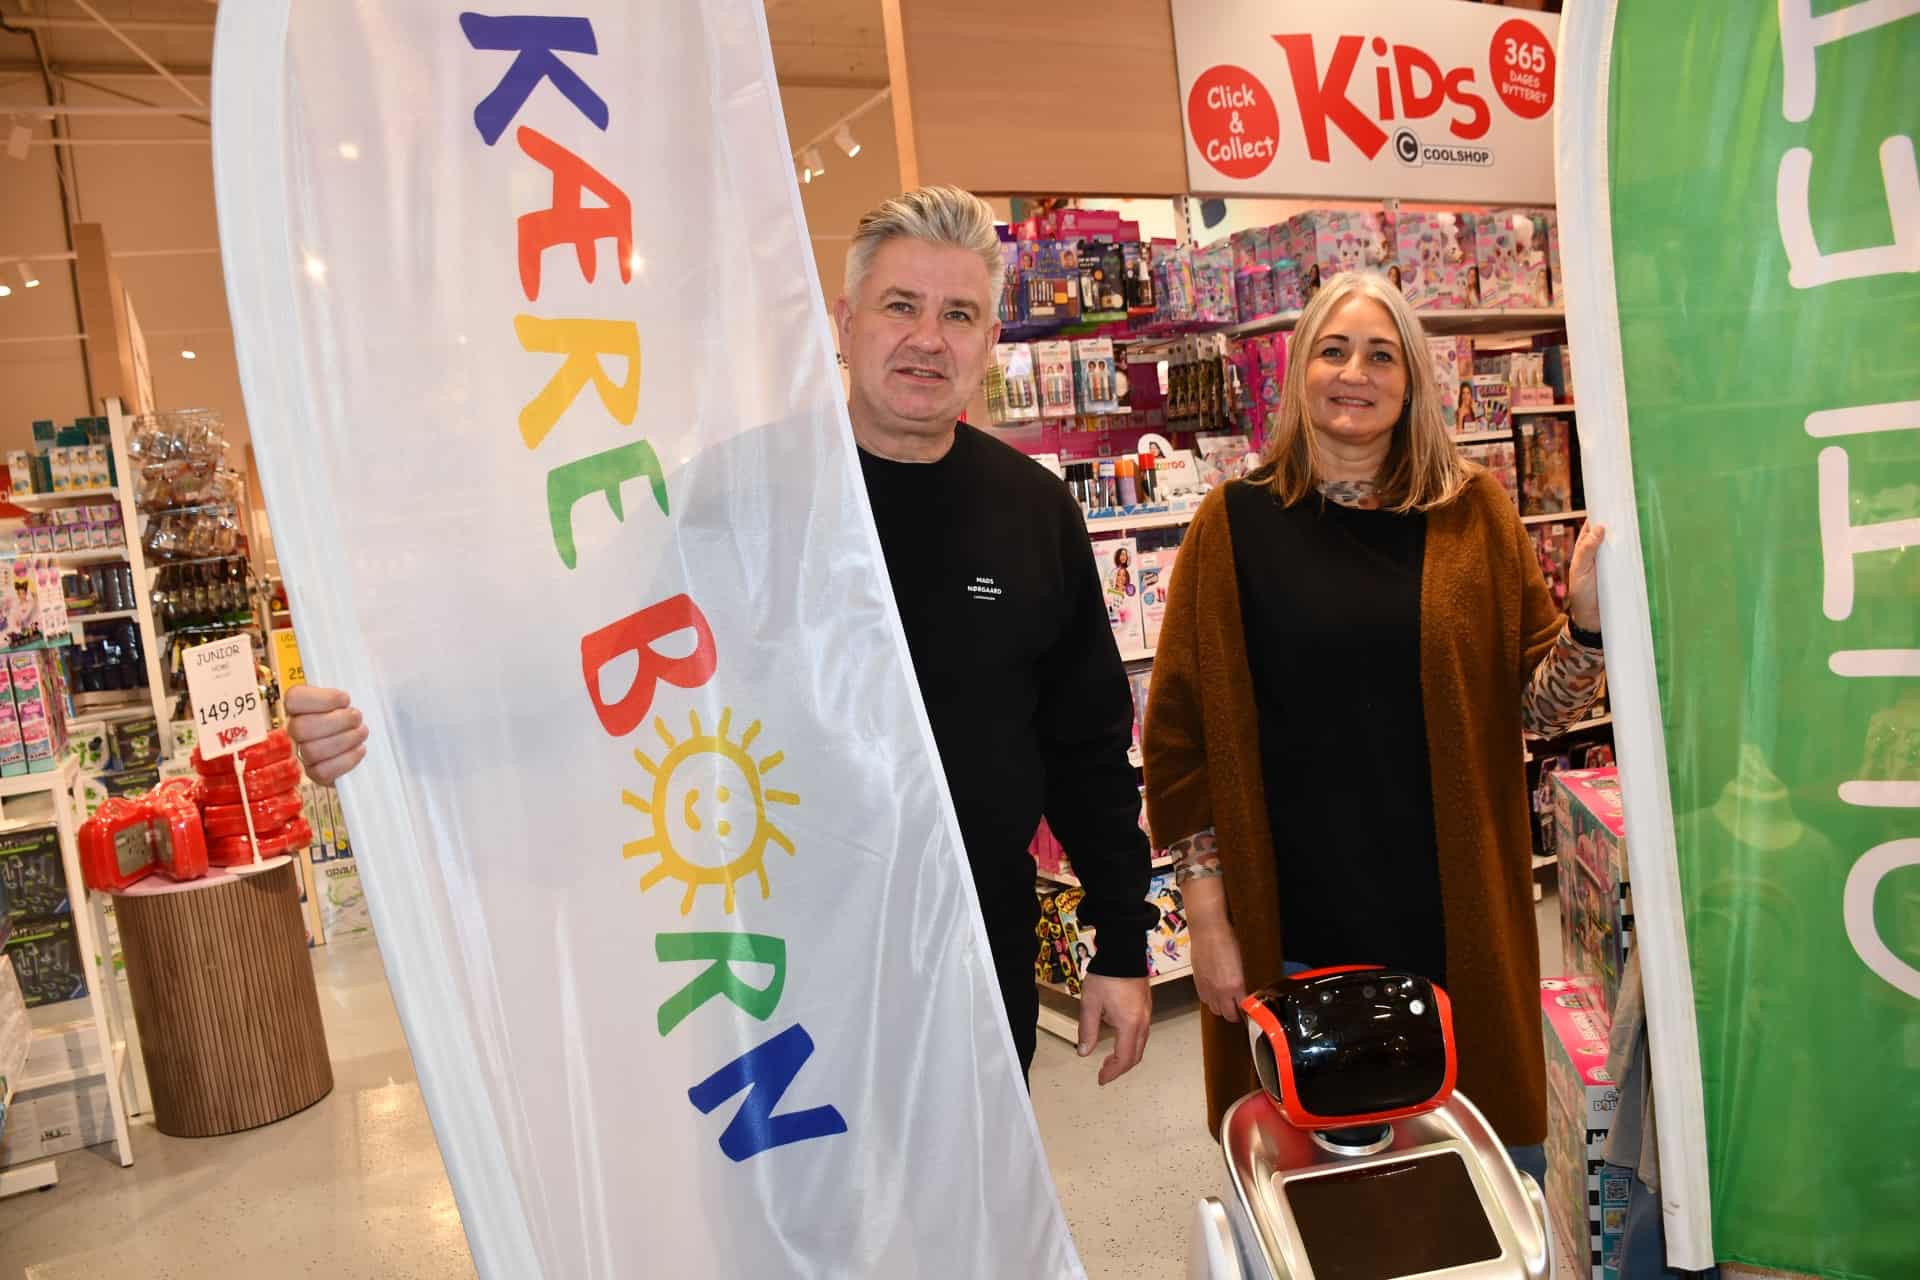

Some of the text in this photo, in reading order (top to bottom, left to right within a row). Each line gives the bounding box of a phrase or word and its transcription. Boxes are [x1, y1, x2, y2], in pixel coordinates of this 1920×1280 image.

[1504, 37, 1546, 74] 365
[1509, 69, 1541, 89] DAGES
[1207, 83, 1257, 110] Click
[1502, 81, 1548, 105] BYTTERET
[1229, 109, 1246, 135] &
[1206, 135, 1274, 162] Collect
[1423, 148, 1489, 163] COOLSHOP
[197, 643, 241, 667] JUNIOR
[200, 692, 257, 726] 149.95
